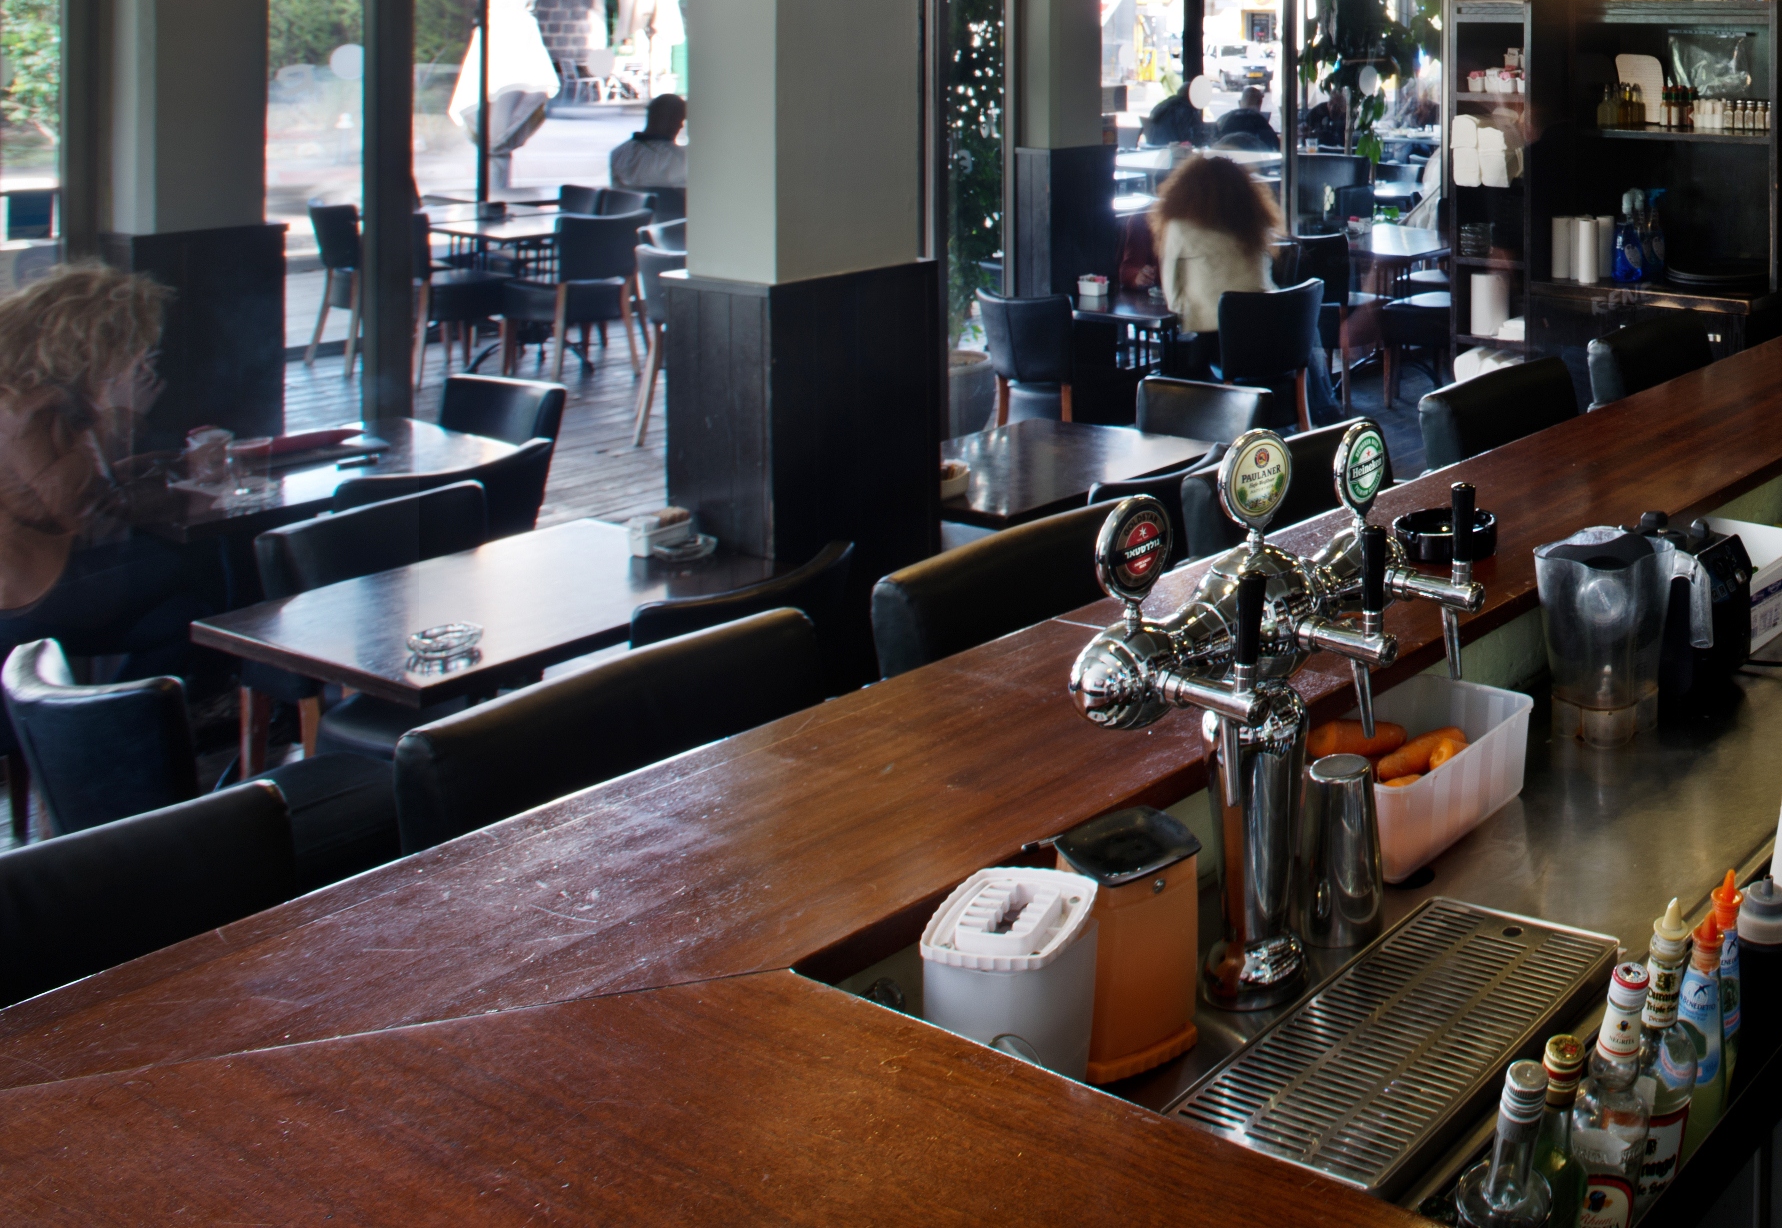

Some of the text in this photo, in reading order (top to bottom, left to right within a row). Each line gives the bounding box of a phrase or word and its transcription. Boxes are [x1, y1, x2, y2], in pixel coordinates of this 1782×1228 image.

[1241, 464, 1281, 484] PAULANER
[1352, 457, 1382, 479] Heineken
[1123, 513, 1158, 537] GOLDSTAR
[1609, 1034, 1635, 1045] NEGRITA
